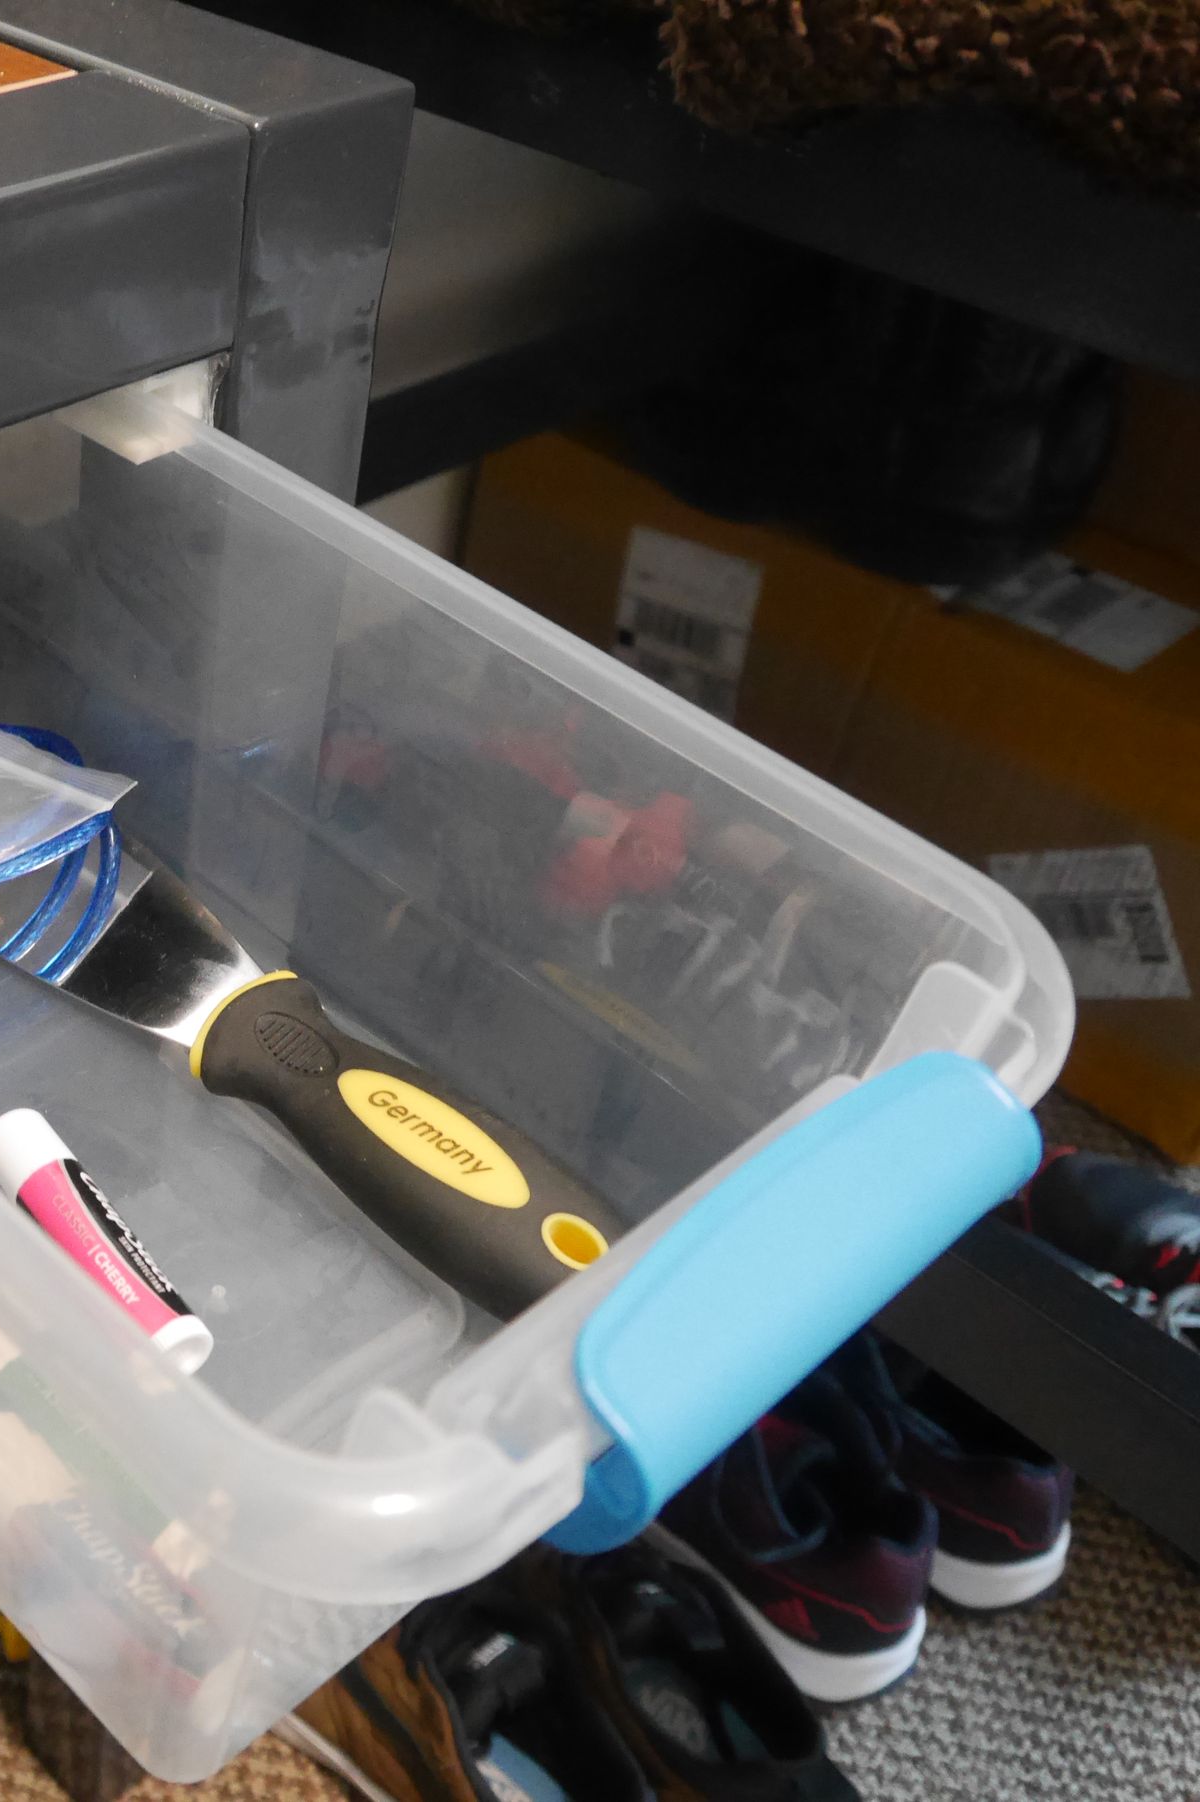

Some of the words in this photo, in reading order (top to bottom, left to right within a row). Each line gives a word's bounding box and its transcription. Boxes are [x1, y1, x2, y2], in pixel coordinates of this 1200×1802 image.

[367, 1089, 494, 1176] Germany
[51, 1194, 95, 1247] CLASSIC
[94, 1251, 140, 1305] CHERRY
[118, 1235, 134, 1253] SKIN
